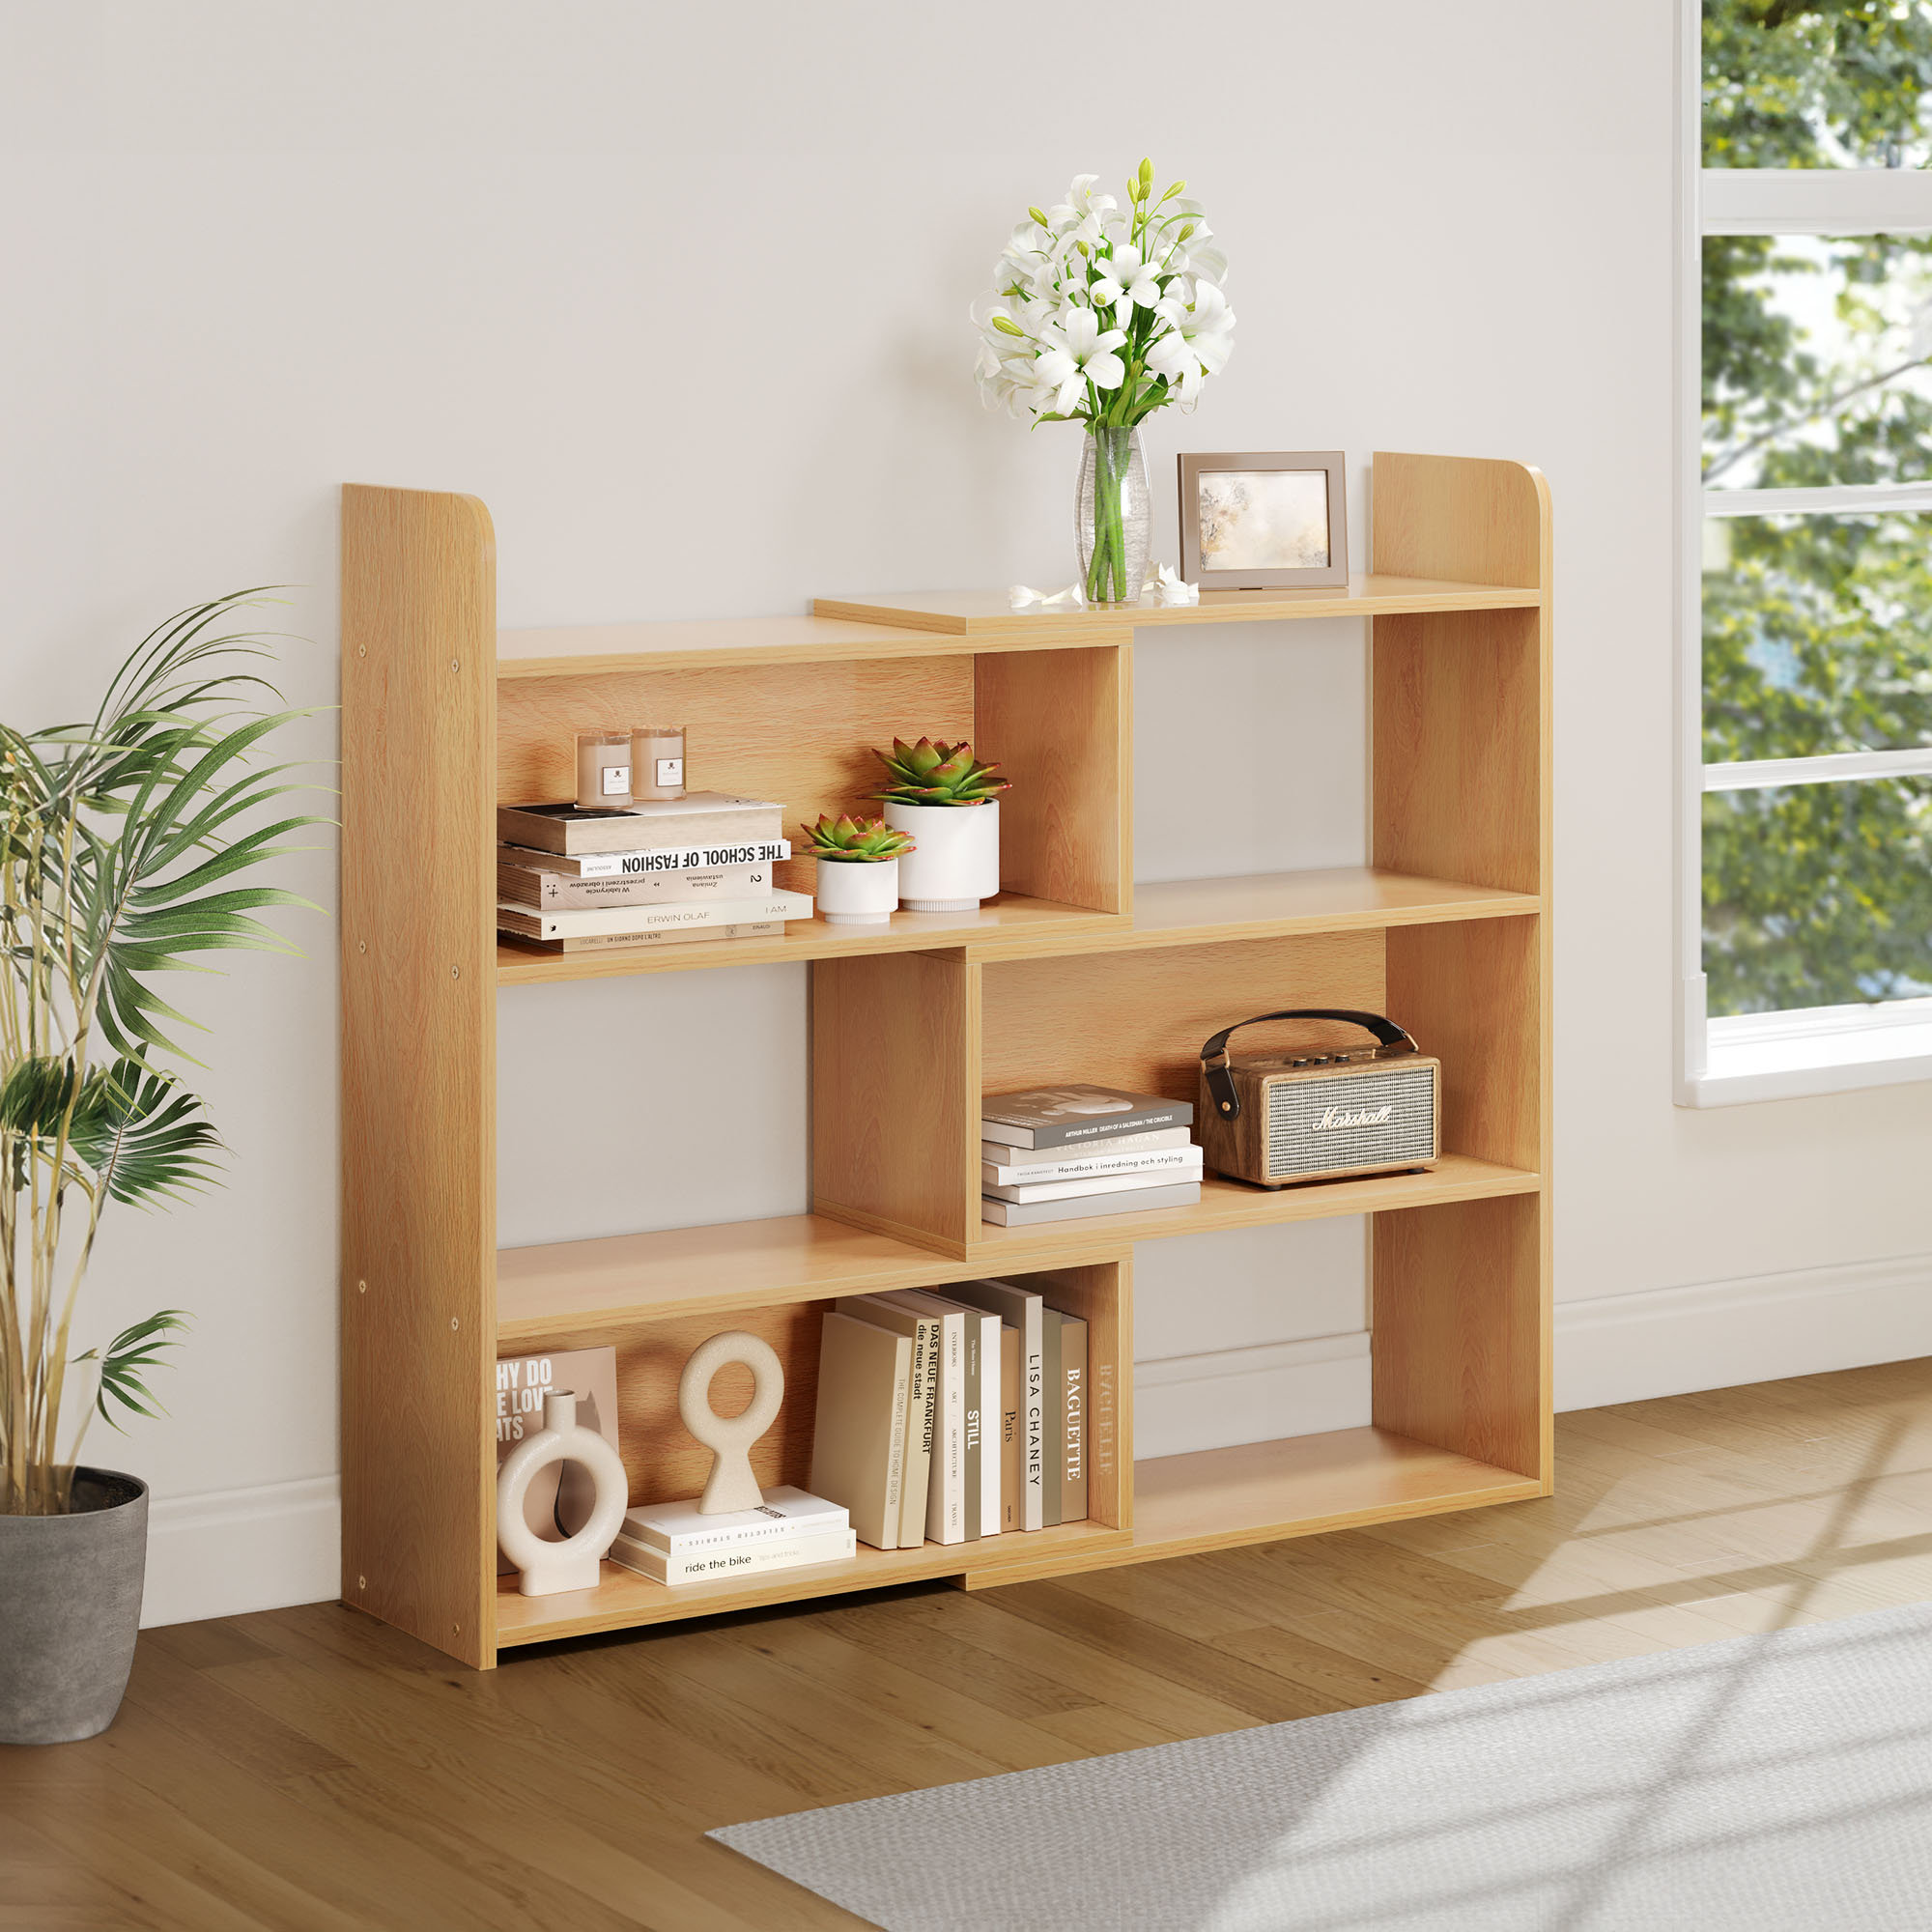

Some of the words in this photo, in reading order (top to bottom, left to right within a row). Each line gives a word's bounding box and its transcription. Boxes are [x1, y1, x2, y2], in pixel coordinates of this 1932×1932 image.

[622, 854, 679, 873] FASHION
[682, 852, 699, 867] OF
[702, 847, 755, 866] SCHOOL
[757, 844, 783, 861] THE
[605, 878, 645, 887] przestrzeni
[750, 874, 762, 883] 2
[647, 914, 681, 924] ERWIN
[683, 911, 710, 922] OLAF
[770, 905, 787, 914] AM
[1065, 1129, 1082, 1138] ARTHUR
[1122, 1121, 1143, 1129] SALESMAN
[1153, 1115, 1173, 1123] CRUCIBLE
[1312, 1105, 1393, 1131] Marshall
[1058, 1163, 1094, 1174] Handbok
[1100, 1160, 1139, 1170] inredning
[1140, 1157, 1155, 1166] och
[1156, 1155, 1183, 1165] styling
[918, 1324, 926, 1341] die
[929, 1324, 940, 1349] DAS
[915, 1344, 923, 1370] neue
[927, 1351, 938, 1383] NEUE
[497, 1361, 521, 1391] HY
[526, 1358, 553, 1387] DO
[897, 1378, 906, 1390] THE
[913, 1372, 923, 1400] stadt
[1029, 1354, 1040, 1397] LISA
[497, 1391, 507, 1416] E
[511, 1385, 554, 1415] LOV
[895, 1392, 905, 1426] COMPLETE
[497, 1415, 524, 1442] ATS
[923, 1386, 935, 1454] FRANKFURT
[967, 1409, 980, 1450] STILL
[1005, 1410, 1017, 1442] Paris
[1066, 1367, 1081, 1481] BAGUETTE
[894, 1427, 902, 1448] GUIDE
[1029, 1407, 1040, 1486] CHANEY
[893, 1449, 901, 1459] TO
[892, 1459, 900, 1478] HOME
[889, 1480, 898, 1505] DESIGN
[685, 1561, 706, 1574] ride
[709, 1559, 726, 1570] the
[729, 1555, 752, 1567] bike
